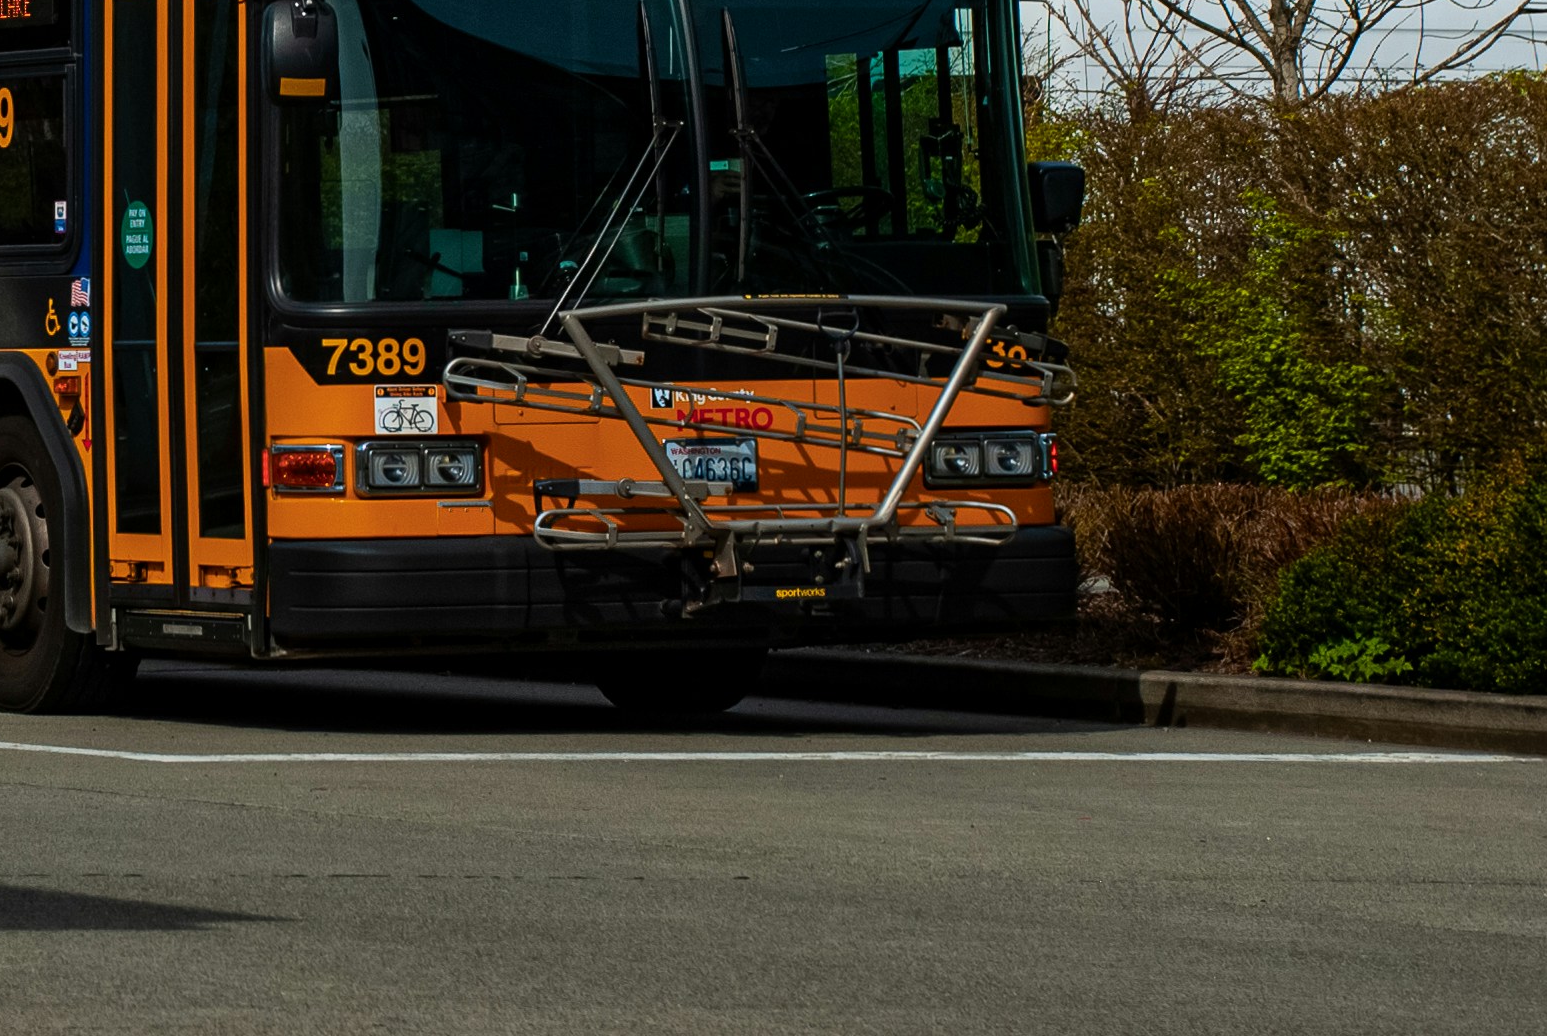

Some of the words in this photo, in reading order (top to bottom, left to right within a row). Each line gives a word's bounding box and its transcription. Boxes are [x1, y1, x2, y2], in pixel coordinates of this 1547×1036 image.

[321, 337, 426, 376] 7389
[676, 407, 773, 432] METRO
[670, 447, 722, 456] WASHINGTON
[776, 587, 827, 600] sportworks
